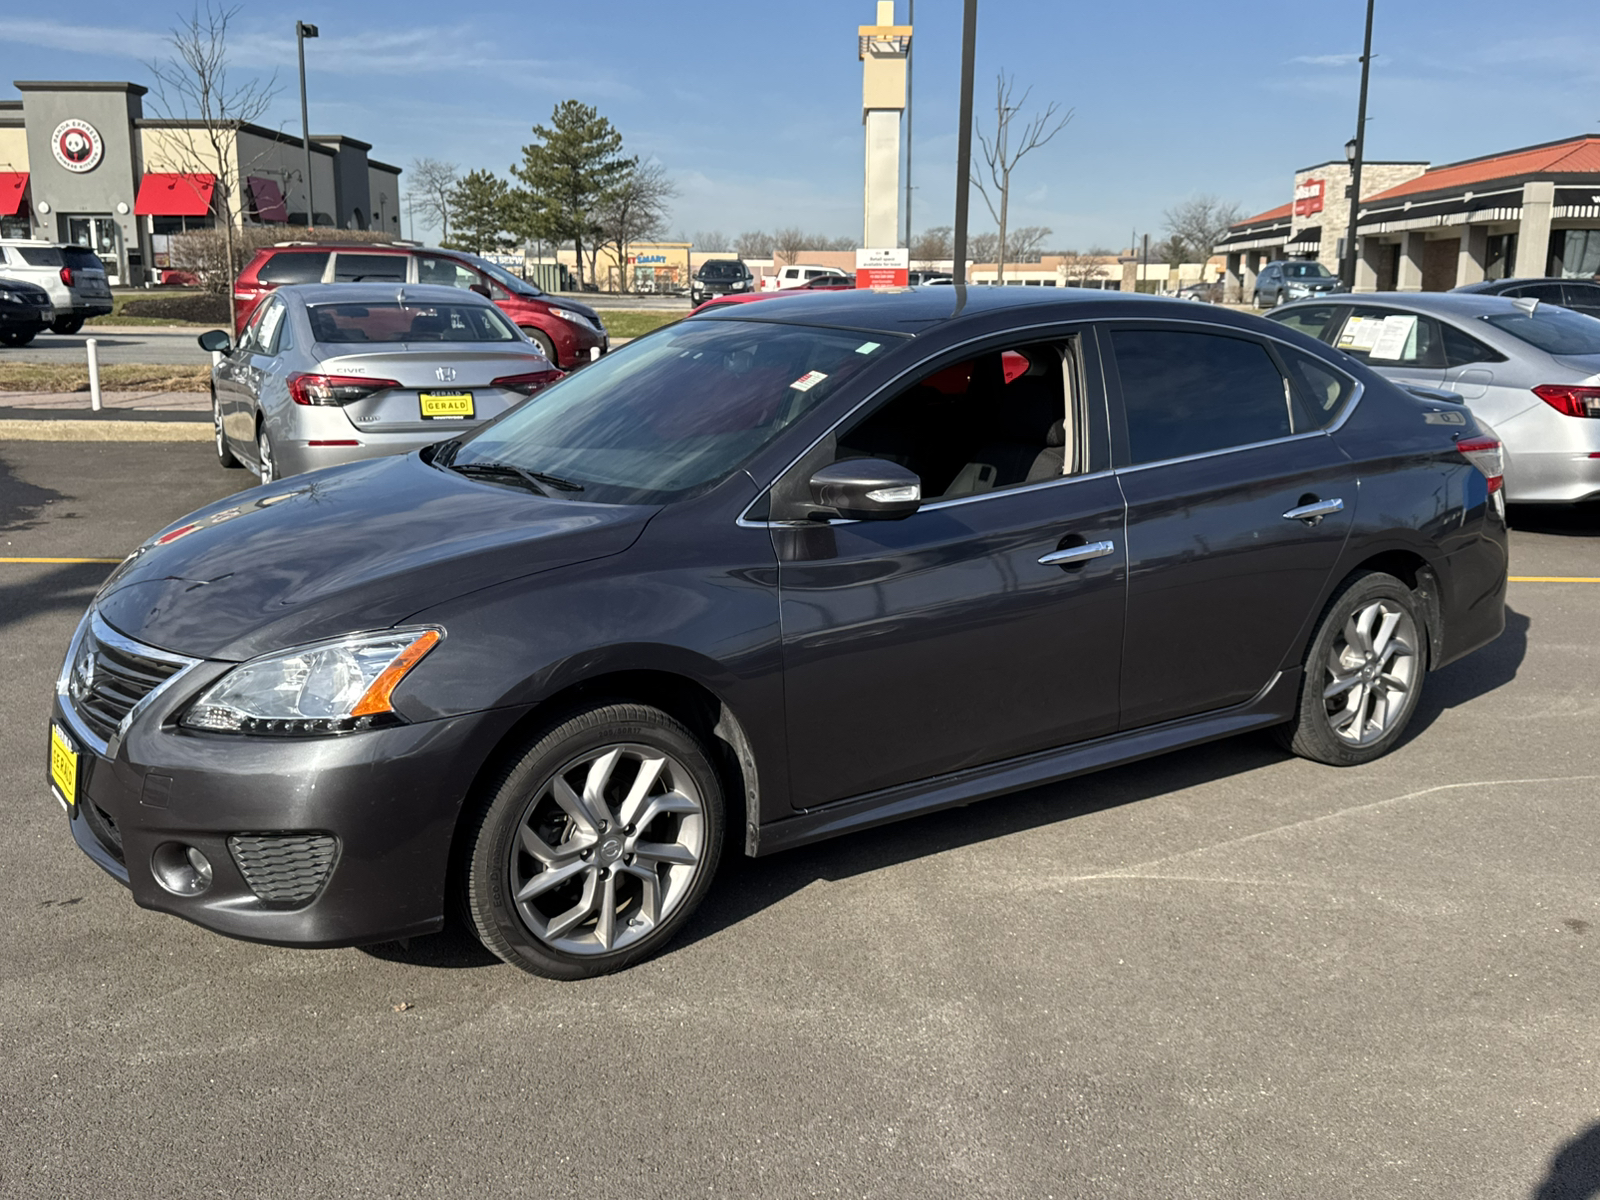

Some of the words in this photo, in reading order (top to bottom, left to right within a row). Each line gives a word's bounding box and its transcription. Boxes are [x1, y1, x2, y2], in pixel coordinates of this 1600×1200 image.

[53, 122, 70, 143] PANDA
[72, 121, 99, 144] EXPRESS
[489, 825, 507, 881] Dynamic
[492, 884, 502, 908] Eco
